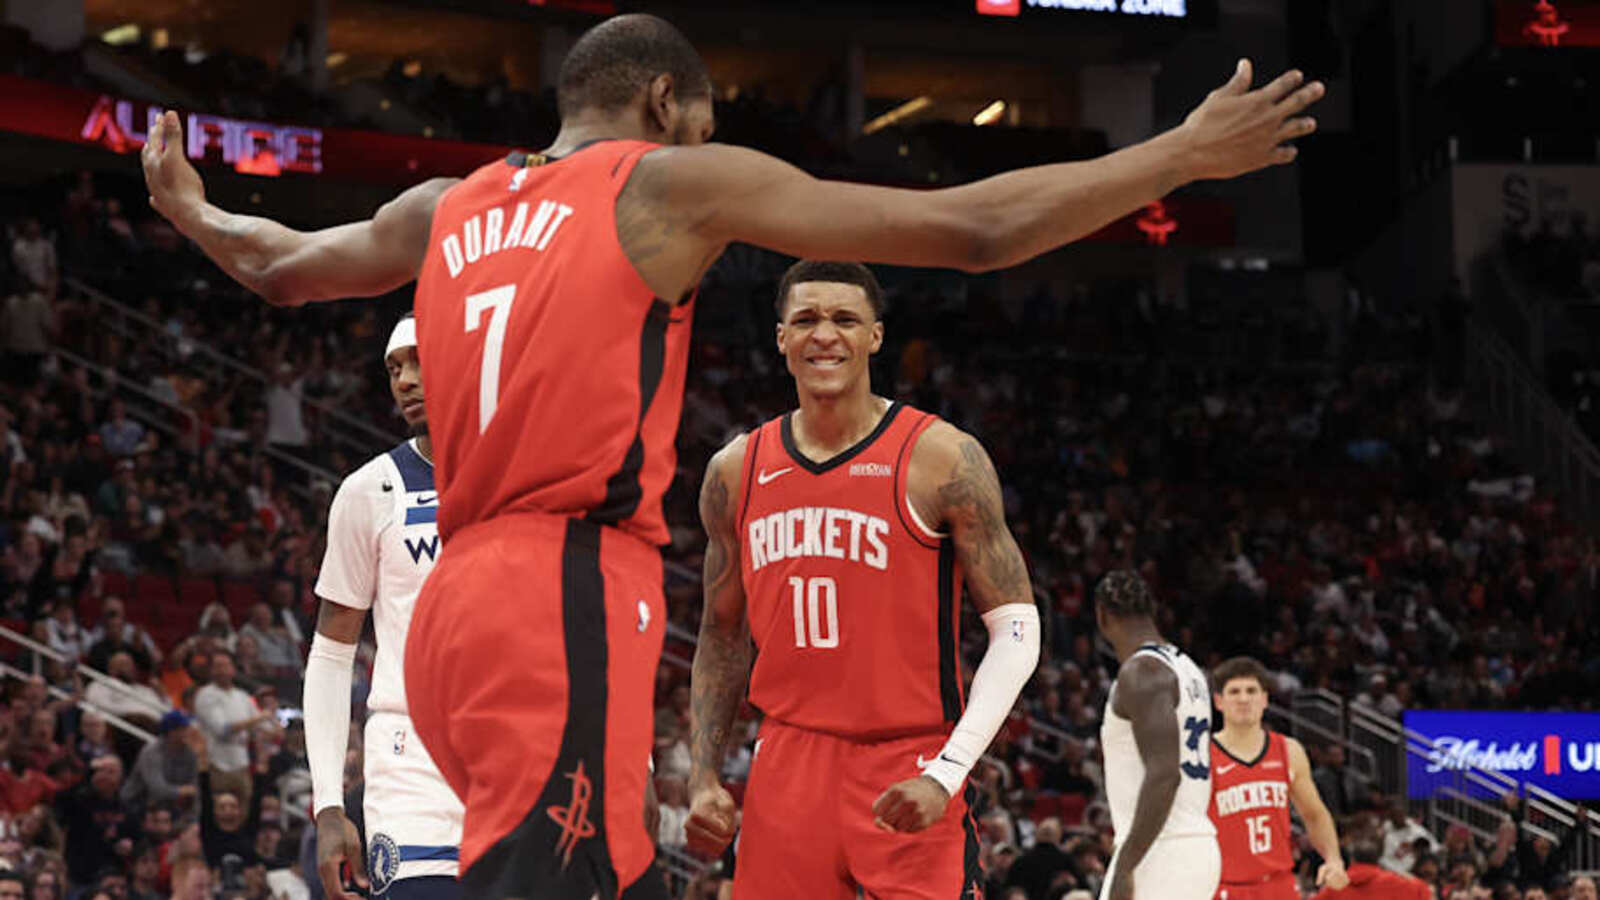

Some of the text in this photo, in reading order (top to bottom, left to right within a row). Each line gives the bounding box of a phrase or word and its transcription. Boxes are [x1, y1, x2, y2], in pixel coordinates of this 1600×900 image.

[442, 200, 573, 278] DURANT
[464, 283, 517, 435] 7
[748, 506, 890, 572] ROCKETS
[788, 576, 839, 648] 10
[1568, 742, 1600, 772] U
[1215, 780, 1289, 818] ROCKETS
[1245, 815, 1272, 854] 15
